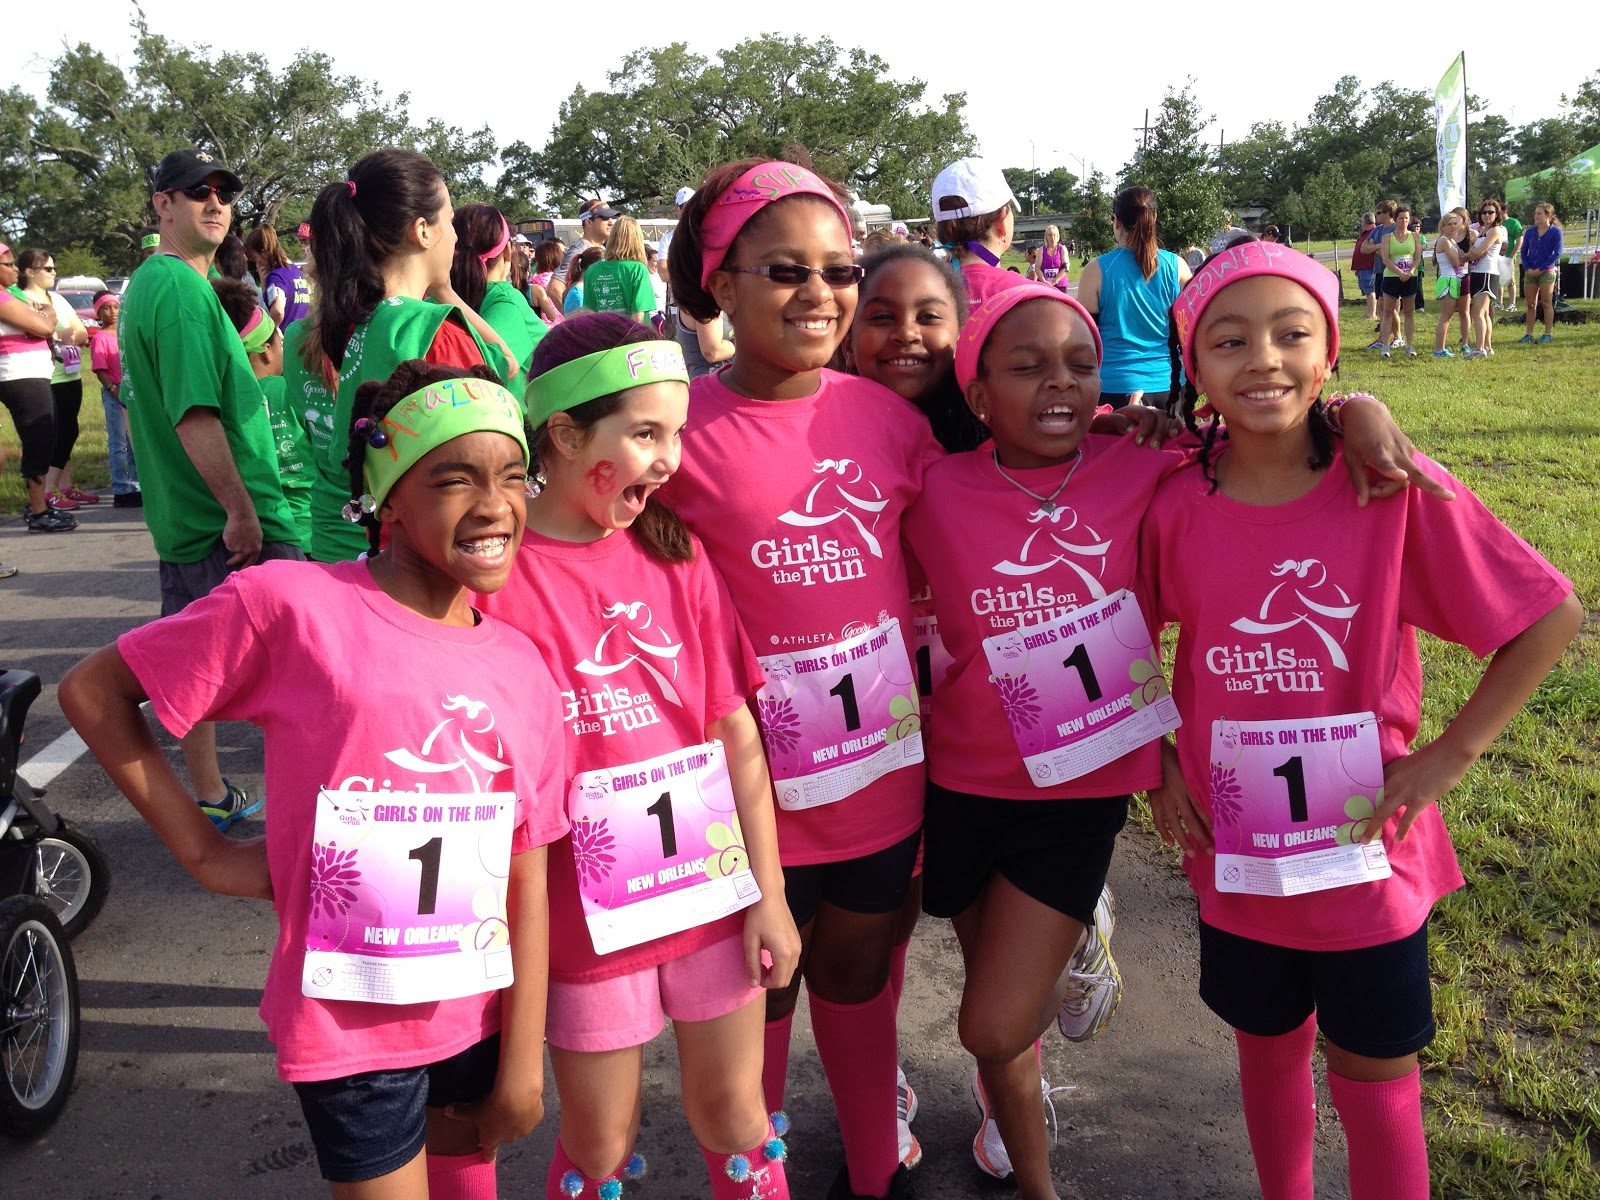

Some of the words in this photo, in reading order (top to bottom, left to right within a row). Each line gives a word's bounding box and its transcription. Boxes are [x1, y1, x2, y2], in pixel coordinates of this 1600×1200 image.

[751, 534, 841, 569] Girls
[841, 545, 861, 558] on
[772, 569, 801, 585] the
[802, 558, 867, 586] run
[971, 582, 1057, 616] Girls
[1057, 591, 1078, 604] on
[782, 632, 834, 645] ATHLETA
[990, 615, 1015, 628] the
[1023, 629, 1058, 650] GIRLS
[1060, 623, 1077, 640] ON
[1078, 612, 1101, 633] THE
[1101, 600, 1122, 621] RUN
[794, 656, 829, 674] GIRLS
[831, 651, 848, 667] ON
[849, 642, 869, 661] THE
[870, 632, 888, 652] RUN
[1206, 642, 1297, 675] Girls
[1298, 656, 1319, 669] on
[1062, 643, 1103, 703] 1
[1225, 677, 1252, 692] the
[1252, 670, 1324, 695] run
[632, 690, 652, 704] on
[829, 673, 861, 733] 1
[572, 719, 601, 736] the
[602, 701, 661, 735] run
[1056, 717, 1085, 738] NEW
[1086, 693, 1131, 726] ORLEANS
[812, 745, 839, 764] NEW
[842, 728, 887, 754] ORLEANS
[1240, 730, 1274, 746] GIRLS
[1278, 729, 1298, 745] ON
[1301, 727, 1327, 743] THE
[1331, 724, 1358, 741] RUN
[612, 775, 648, 791] GIRLS
[650, 768, 666, 783] ON
[667, 762, 687, 780] THE
[687, 753, 709, 773] RUN
[1273, 756, 1309, 823] 1
[374, 805, 417, 823] GIRLS
[423, 806, 443, 822] ON
[448, 806, 471, 822] THE
[474, 804, 497, 821] RUN
[646, 791, 678, 859] 1
[1252, 832, 1280, 849] NEW
[1284, 825, 1338, 846] ORLEANS
[408, 837, 443, 915] 1
[627, 871, 656, 894] NEW
[658, 858, 707, 885] ORLEANS
[364, 926, 401, 946] NEW
[404, 924, 465, 946] ORLEANS
